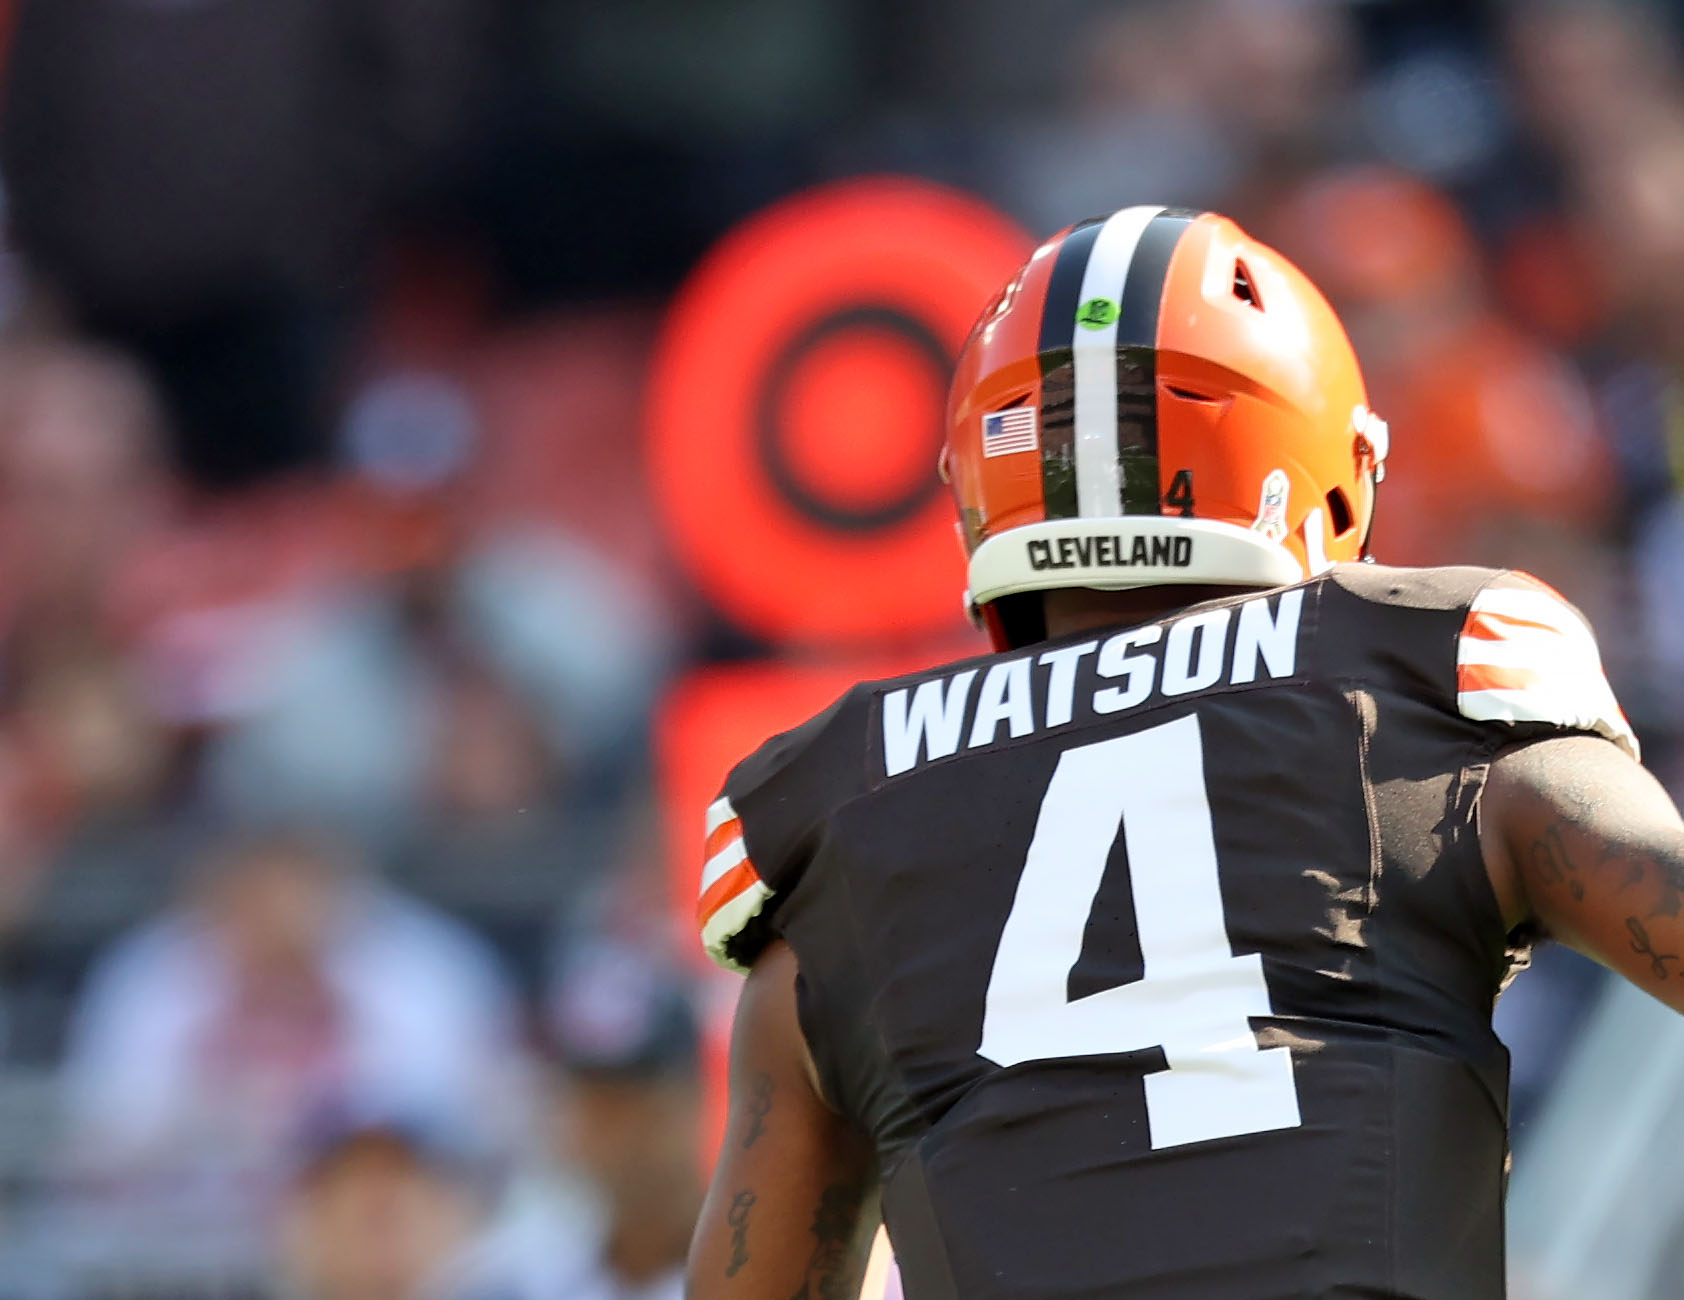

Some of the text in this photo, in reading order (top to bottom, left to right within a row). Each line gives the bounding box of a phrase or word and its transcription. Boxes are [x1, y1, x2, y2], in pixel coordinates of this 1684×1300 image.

[1027, 535, 1194, 571] CLEVELAND
[1166, 470, 1196, 518] 4
[881, 589, 1306, 778] WATSON
[976, 713, 1302, 1151] 4
